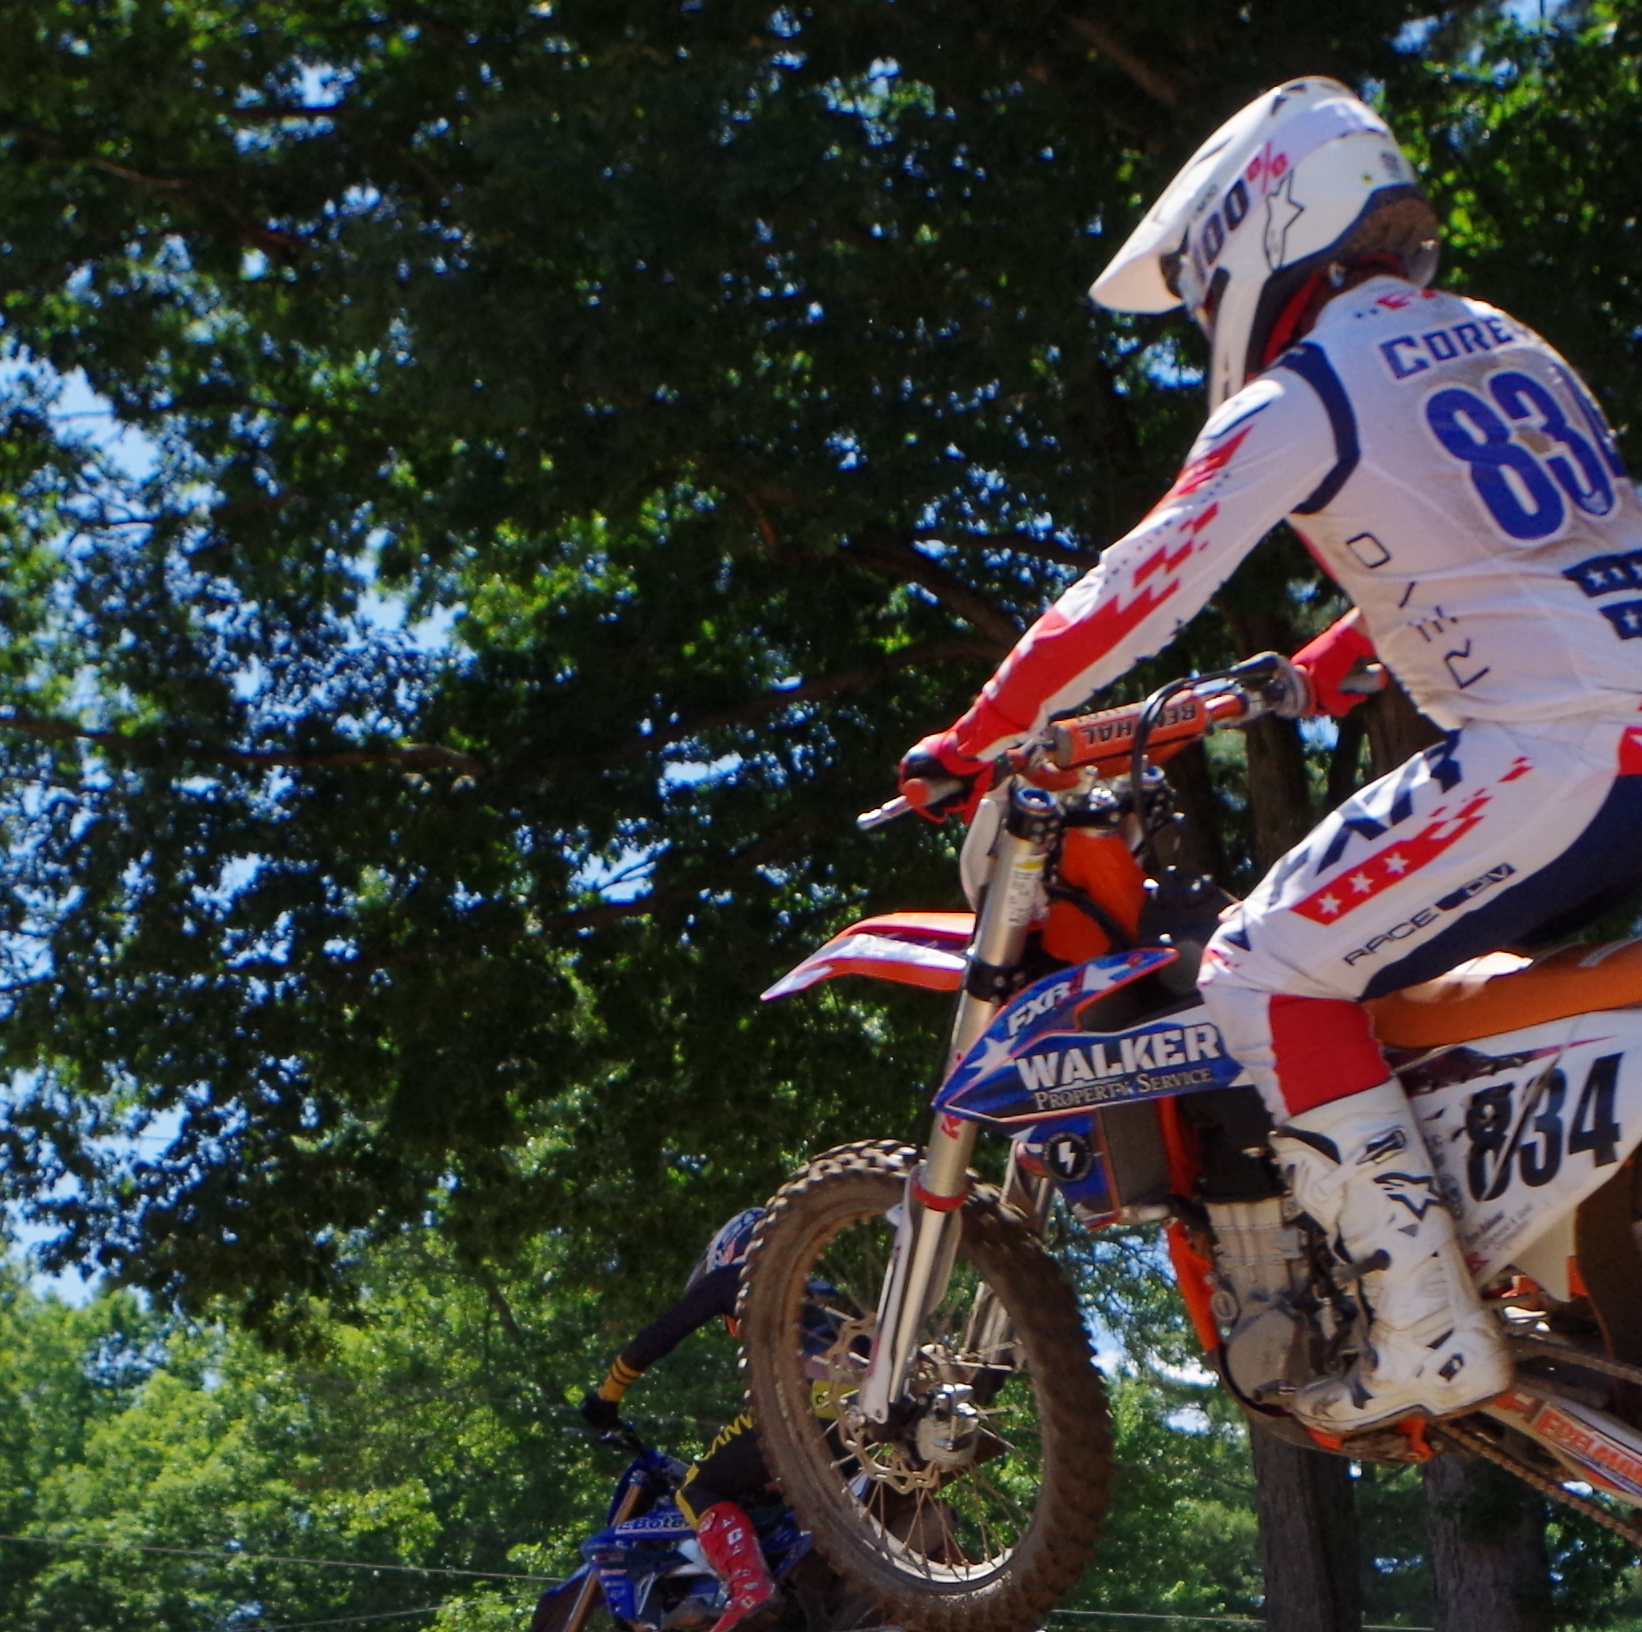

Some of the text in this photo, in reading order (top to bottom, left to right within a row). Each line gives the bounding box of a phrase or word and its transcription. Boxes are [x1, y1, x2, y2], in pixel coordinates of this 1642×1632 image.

[1192, 140, 1288, 284] 100%
[1080, 702, 1196, 745] RENHAL
[1343, 861, 1517, 967] RACE DIV
[1005, 981, 1073, 1038] FXR
[1014, 1022, 1226, 1091] WALKER
[1033, 1067, 1213, 1111] PROPERTY SERVICE
[1465, 1052, 1625, 1202] 834
